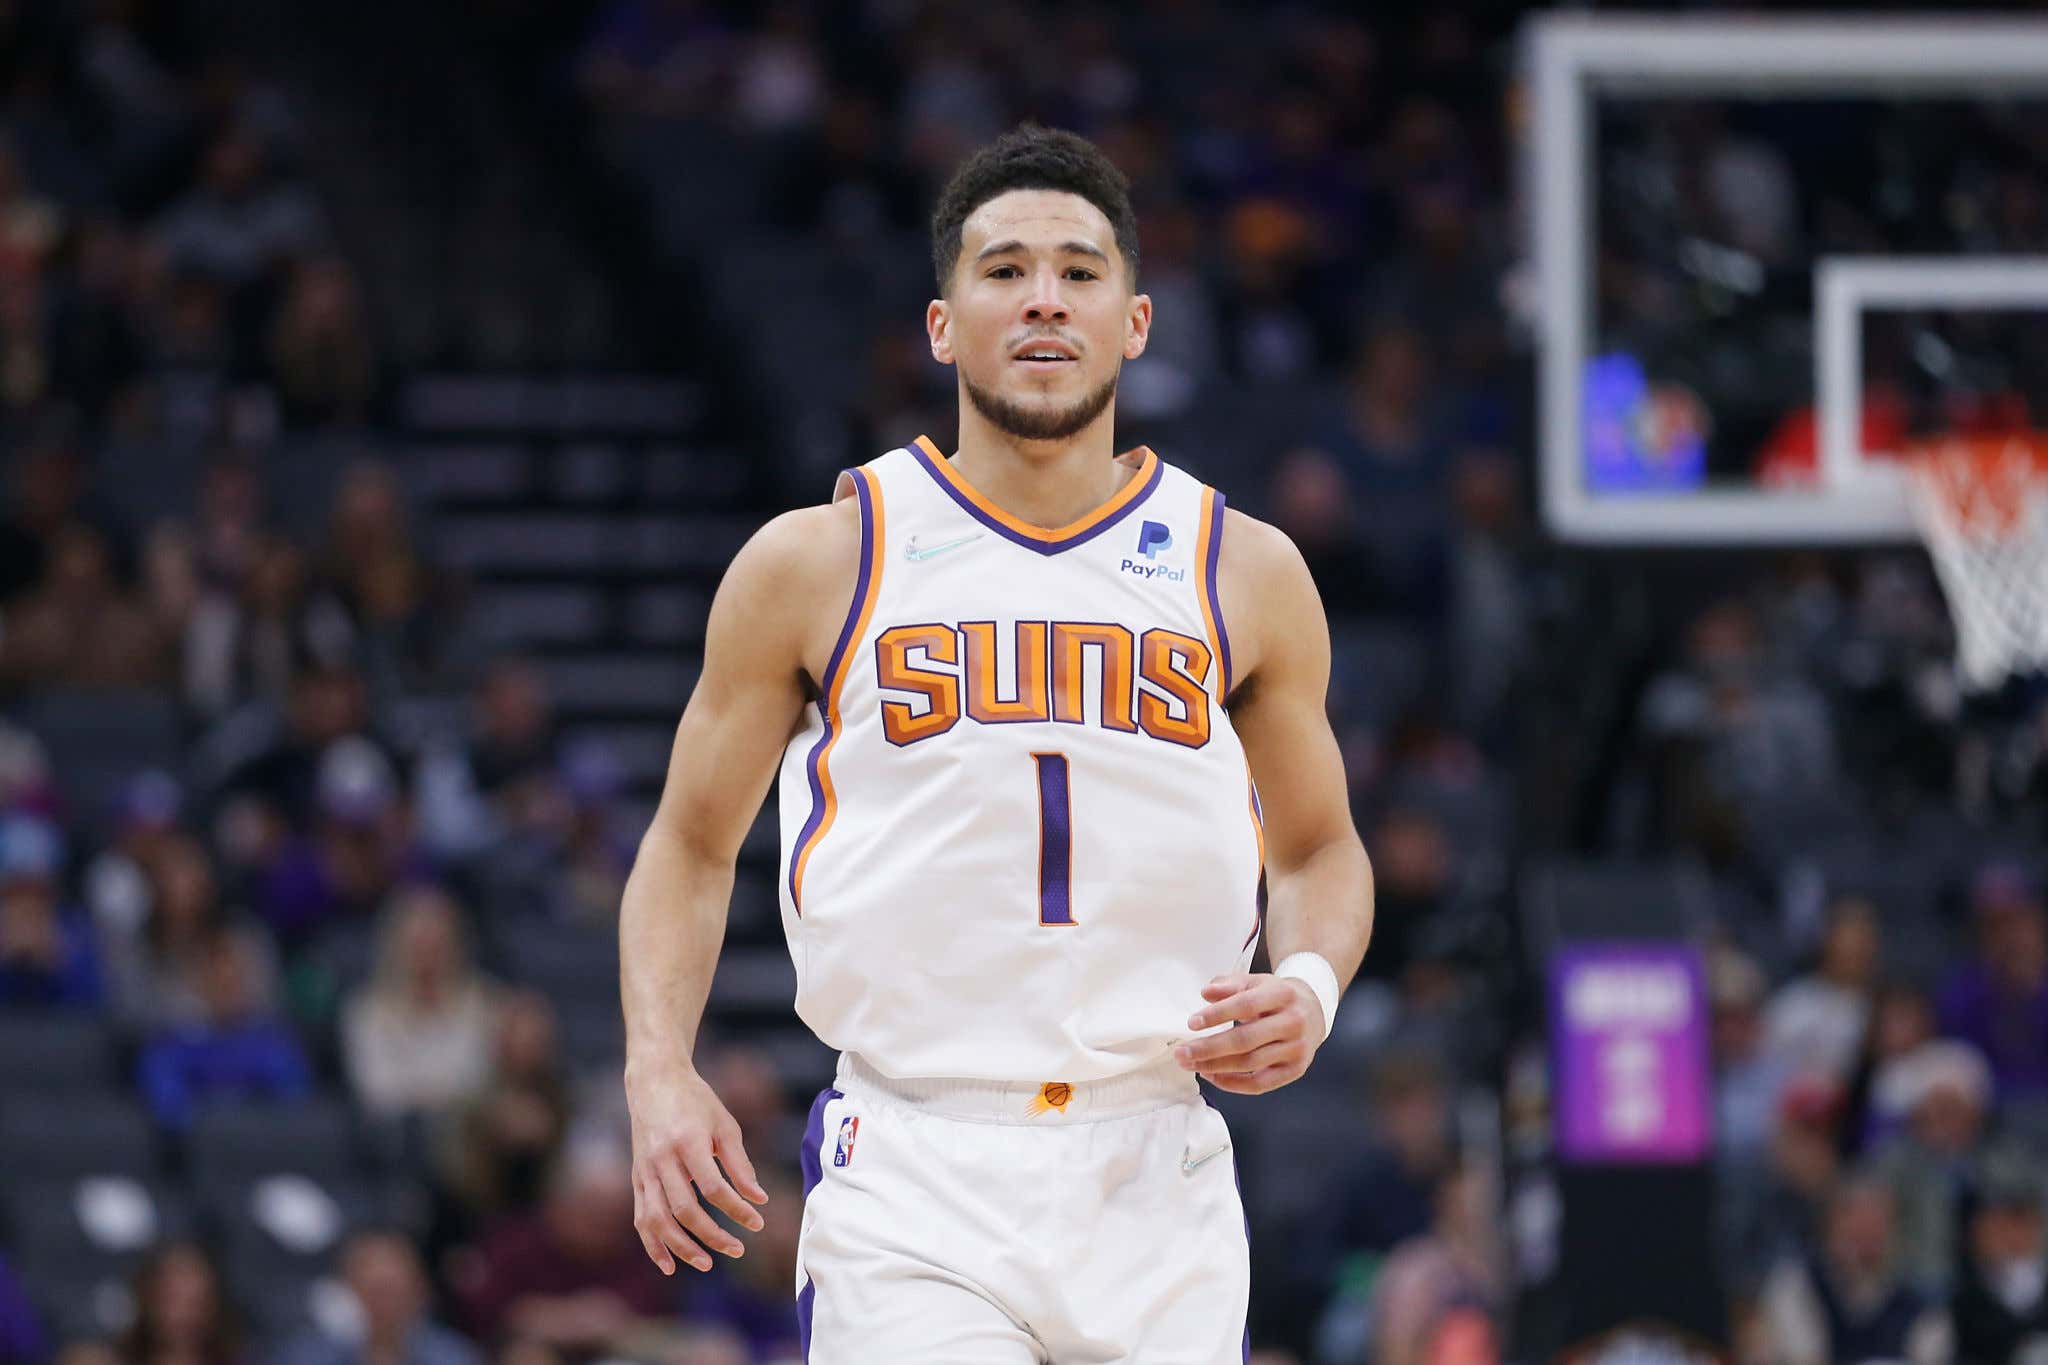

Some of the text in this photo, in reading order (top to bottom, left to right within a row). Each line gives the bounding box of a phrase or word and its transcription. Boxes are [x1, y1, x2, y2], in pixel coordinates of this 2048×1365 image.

[1121, 560, 1184, 581] PayPal
[874, 620, 1212, 750] SUNS
[1029, 752, 1079, 926] 1
